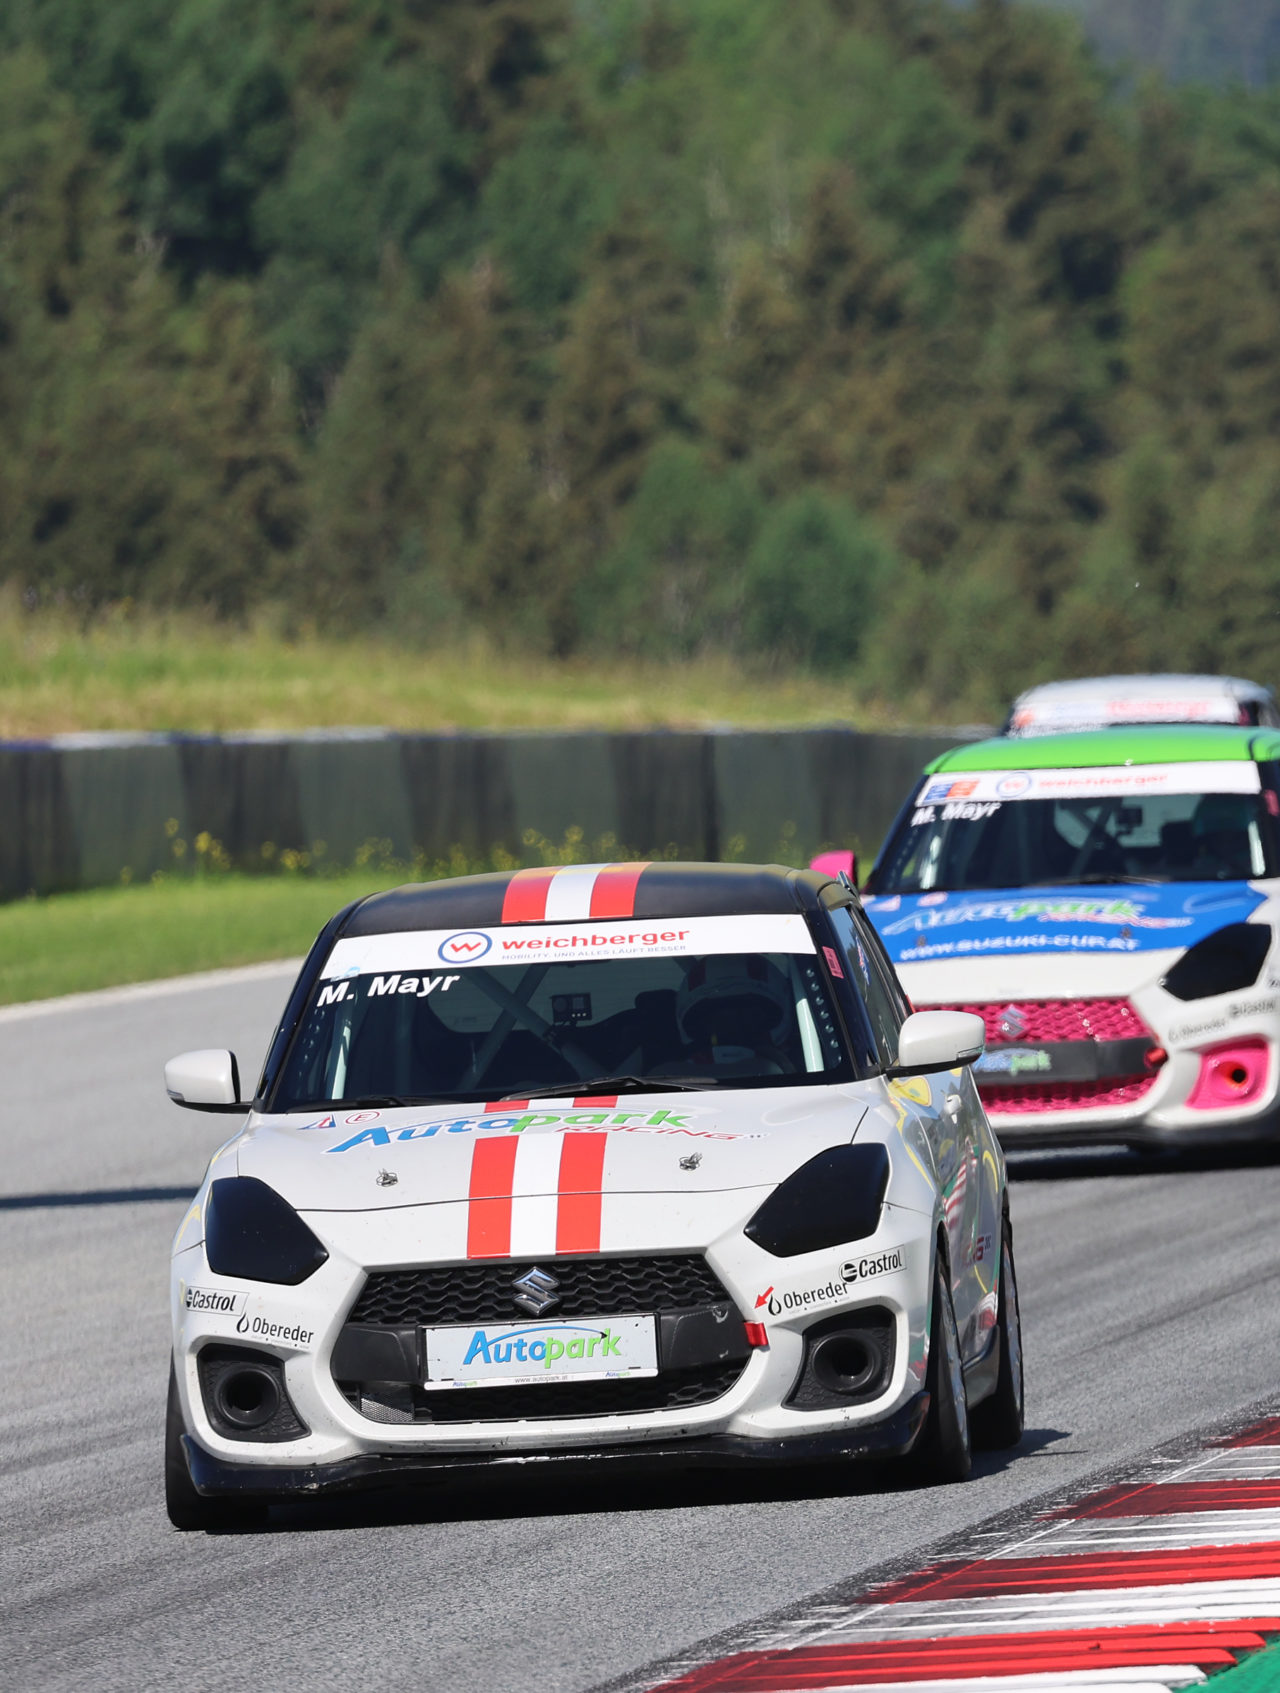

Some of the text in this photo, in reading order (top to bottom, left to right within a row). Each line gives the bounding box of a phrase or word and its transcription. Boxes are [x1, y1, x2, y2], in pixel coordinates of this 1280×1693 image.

[941, 800, 1001, 821] Mayr
[502, 929, 691, 951] weichberger
[316, 974, 461, 1007] M. Mayr
[325, 1109, 692, 1153] Autopark
[555, 1125, 744, 1140] RACING
[859, 1249, 903, 1278] Castrol
[192, 1290, 237, 1312] Castrol
[783, 1282, 849, 1309] Obereder
[252, 1317, 314, 1344] Obereder
[463, 1327, 622, 1369] Autopark
